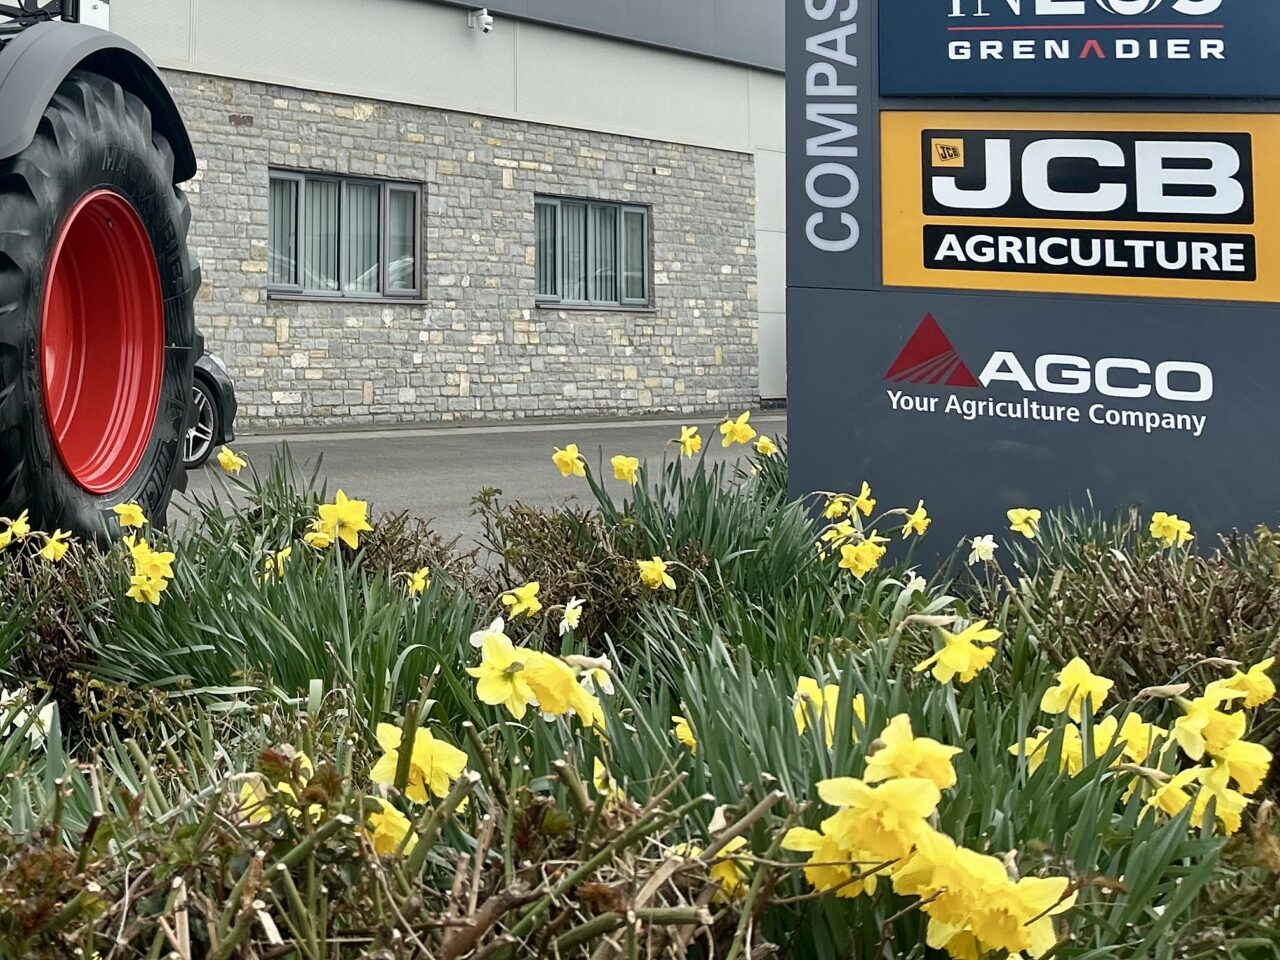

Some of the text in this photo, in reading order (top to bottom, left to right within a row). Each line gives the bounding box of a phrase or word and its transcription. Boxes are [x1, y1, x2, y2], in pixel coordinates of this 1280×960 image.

[947, 38, 1226, 60] GRENADIER
[939, 145, 960, 159] JCB
[931, 138, 1245, 215] JCB
[934, 233, 1246, 272] AGRICULTURE
[978, 351, 1214, 401] AGCO
[887, 390, 1207, 436] Your Agriculture Company
